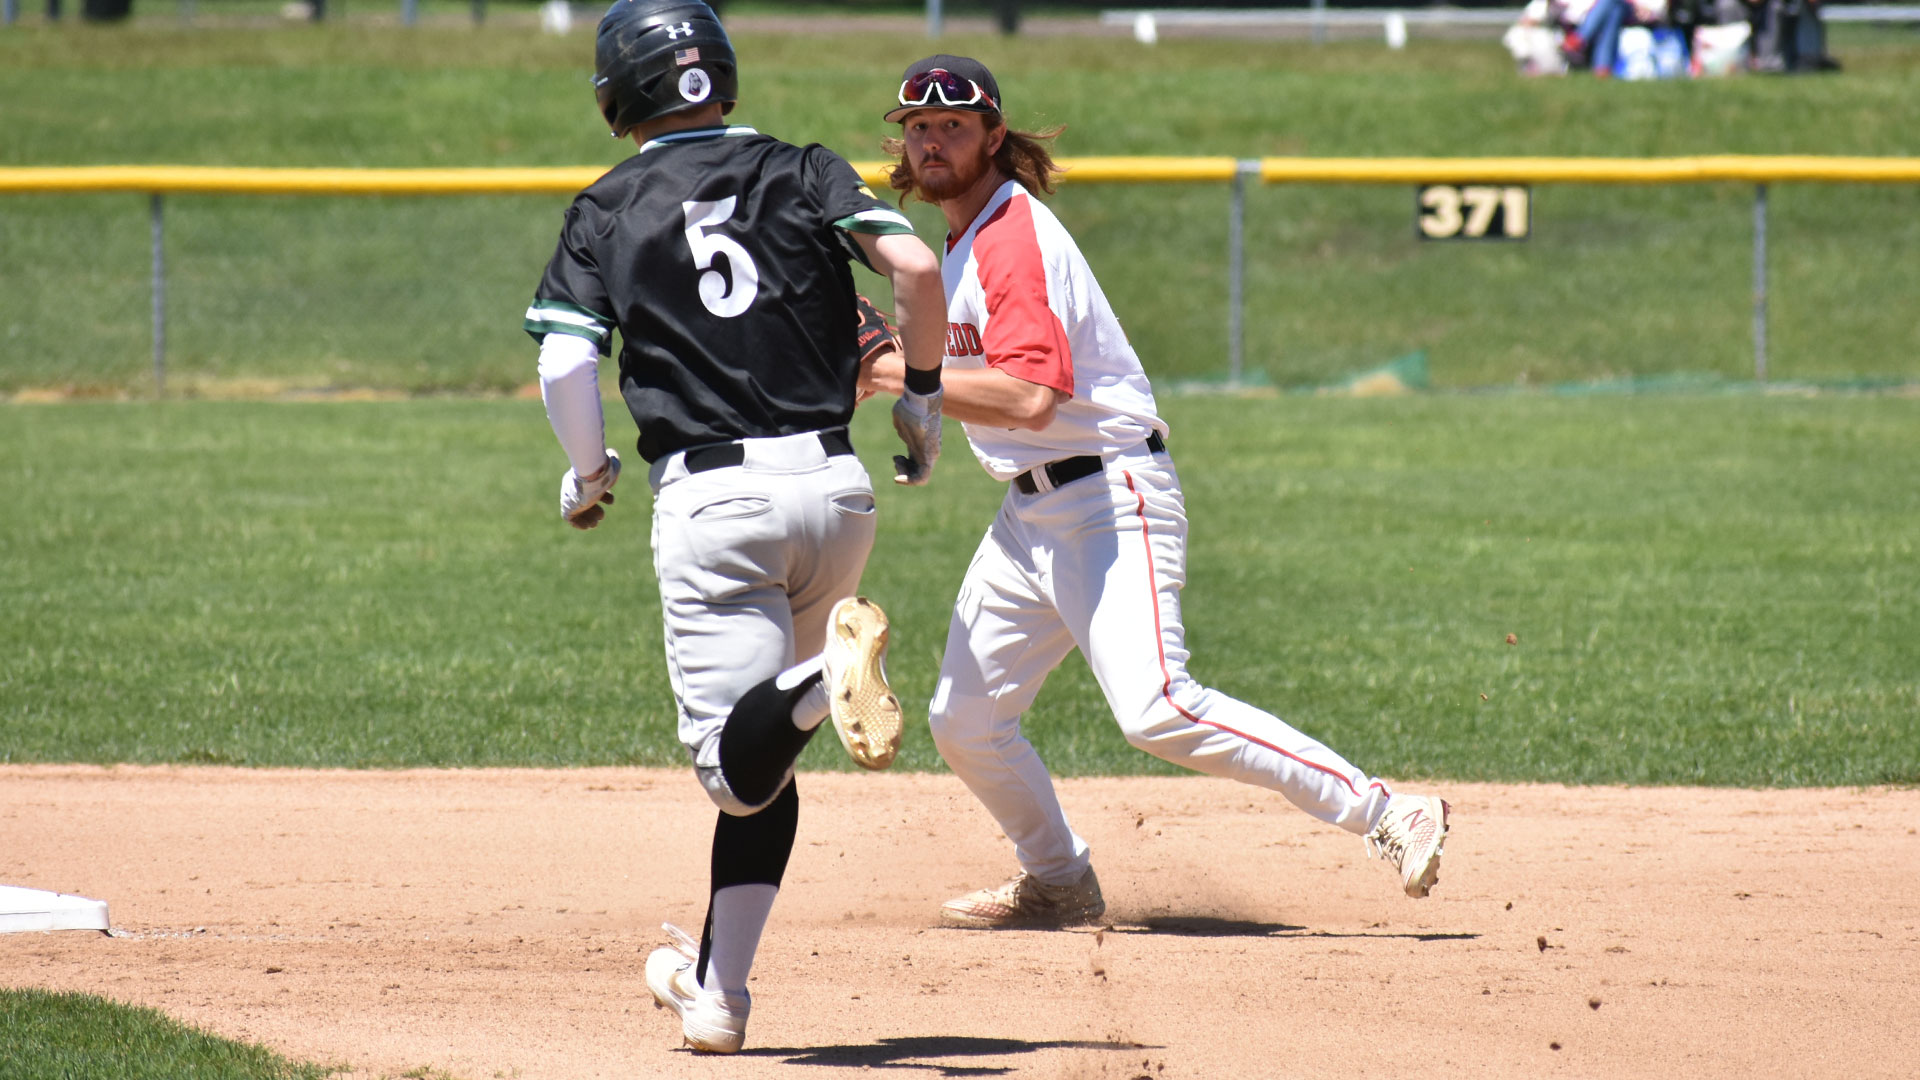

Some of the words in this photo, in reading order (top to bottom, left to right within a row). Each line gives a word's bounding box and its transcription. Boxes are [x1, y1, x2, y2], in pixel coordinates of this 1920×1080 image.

[1421, 185, 1528, 238] 371
[682, 195, 759, 318] 5
[944, 322, 984, 357] EDD
